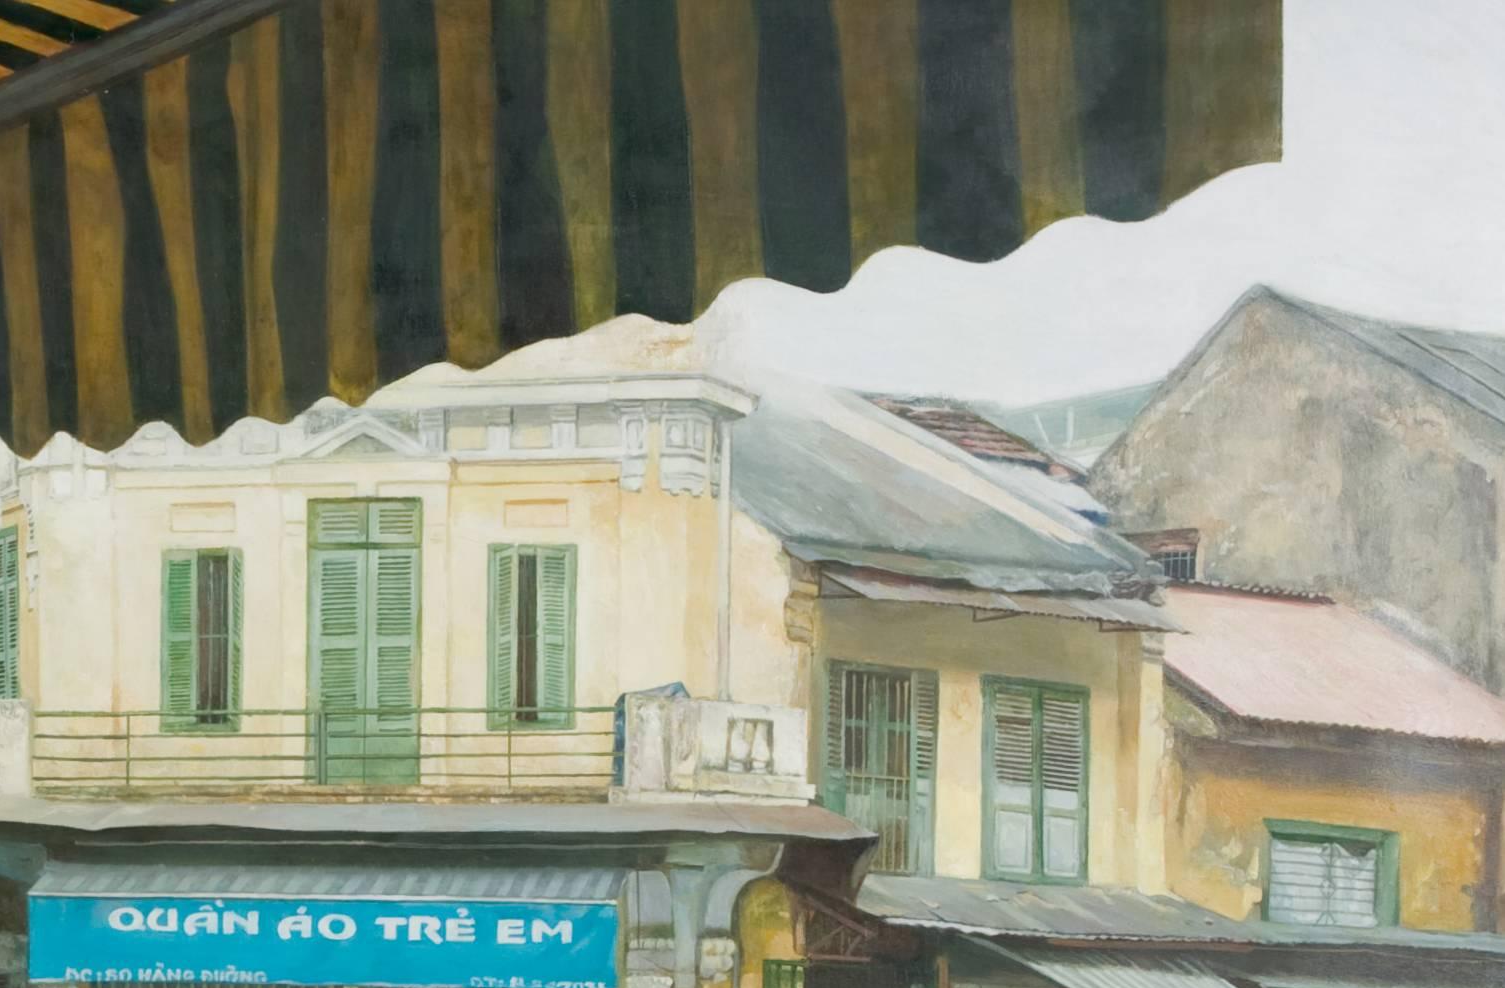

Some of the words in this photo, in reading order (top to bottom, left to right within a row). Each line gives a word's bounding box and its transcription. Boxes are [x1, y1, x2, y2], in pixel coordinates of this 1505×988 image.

[108, 899, 260, 936] QUẦN
[277, 906, 357, 940] ÁO
[374, 907, 477, 945] TRẺ
[496, 918, 573, 945] EM
